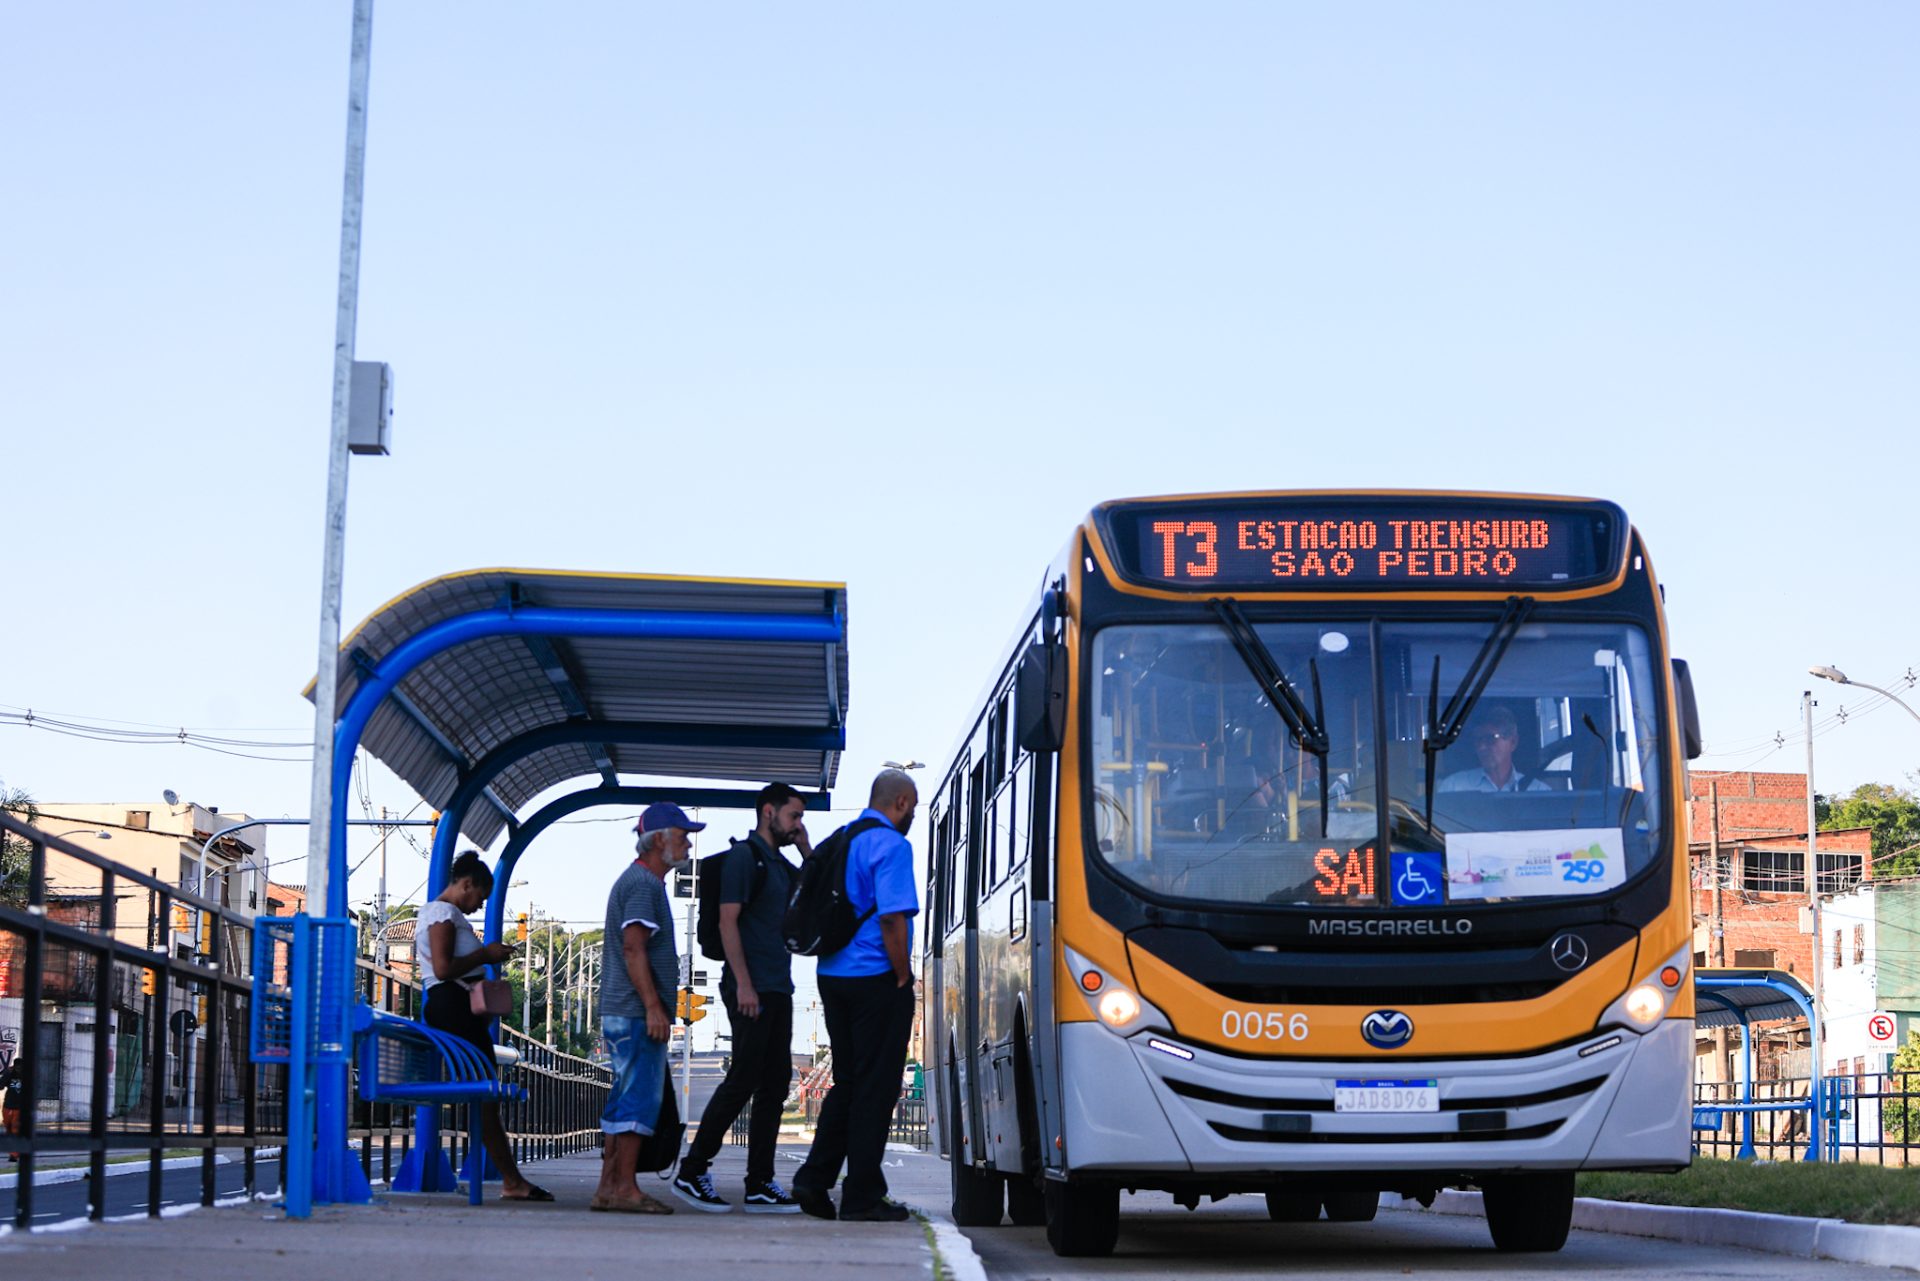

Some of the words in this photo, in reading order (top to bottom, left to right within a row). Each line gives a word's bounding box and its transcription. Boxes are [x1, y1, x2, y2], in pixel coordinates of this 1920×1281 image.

[1238, 521, 1377, 550] ESTACAO
[1388, 520, 1549, 549] TRENSURB
[1153, 521, 1218, 577] T3
[1271, 551, 1355, 576] SAO
[1378, 551, 1517, 576] PEDRO
[1562, 860, 1605, 883] 250
[1308, 919, 1473, 936] MASCARELLO
[1221, 1010, 1309, 1041] 0056
[1345, 1090, 1428, 1110] JAD8D96
